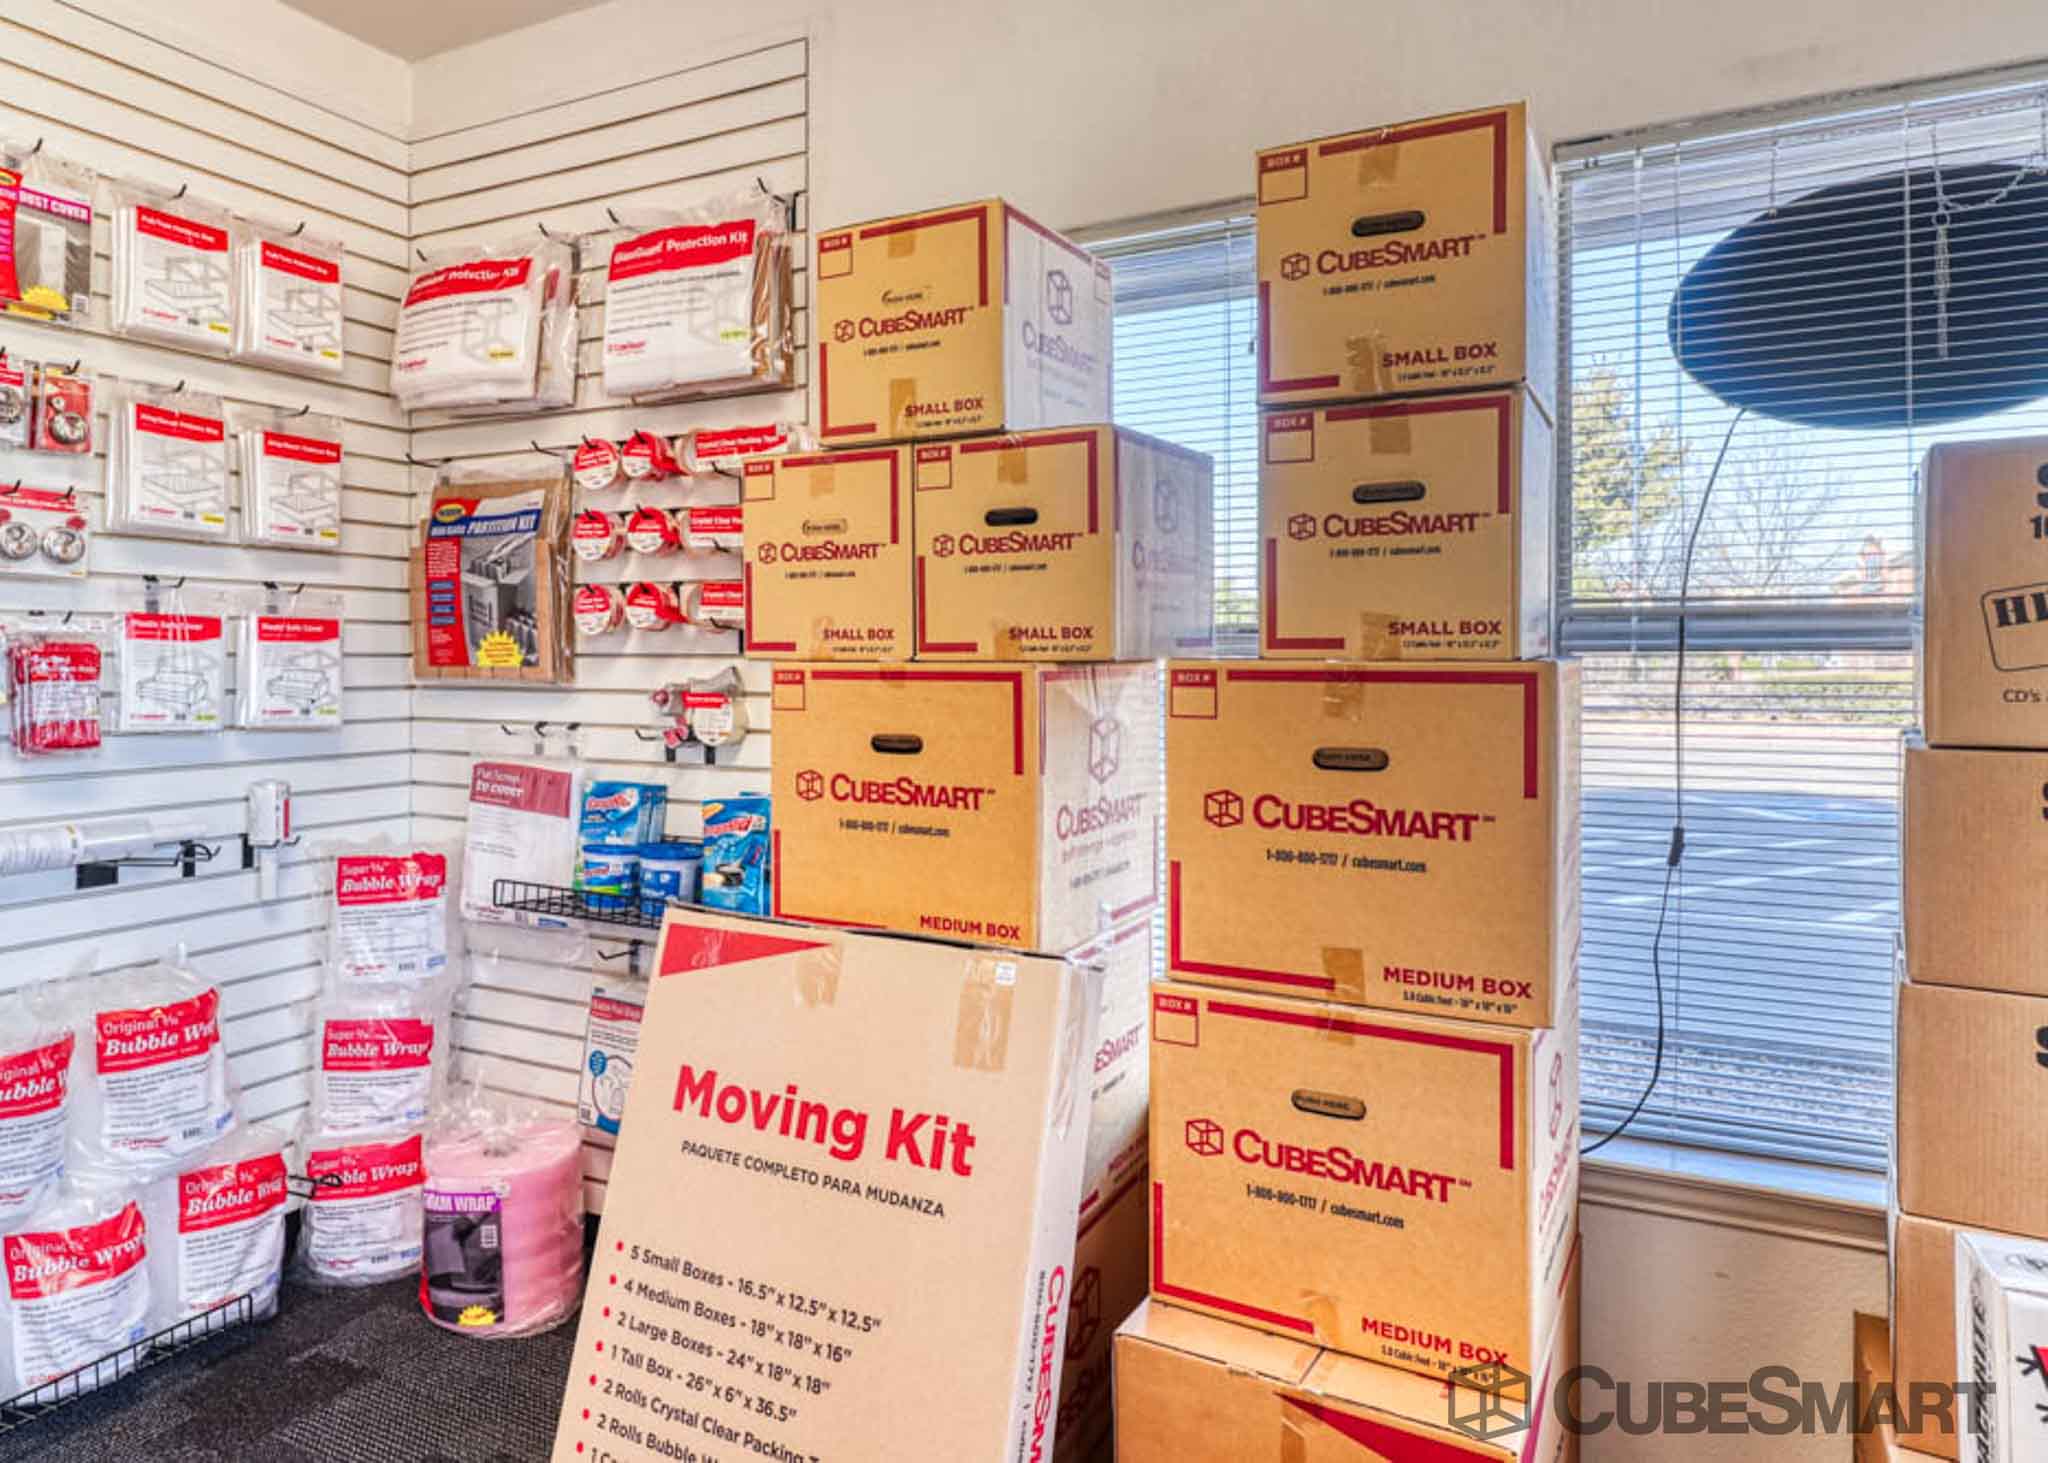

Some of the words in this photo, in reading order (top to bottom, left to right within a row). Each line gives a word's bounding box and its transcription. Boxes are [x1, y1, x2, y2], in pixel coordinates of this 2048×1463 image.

[665, 234, 727, 252] Protection
[728, 231, 749, 244] Kit
[1382, 348, 1449, 368] SMALL
[1454, 341, 1498, 361] BOX
[904, 401, 952, 418] SMALL
[953, 397, 984, 412] BOX
[517, 512, 537, 532] KIT
[823, 627, 865, 641] SMALL
[868, 627, 895, 641] BOX
[1008, 627, 1057, 641] SMALL
[1061, 625, 1094, 640] BOX
[1389, 620, 1454, 635] SMALL
[1459, 619, 1502, 635] BOX
[1177, 673, 1201, 683] BOX
[1352, 857, 1427, 873] cubesmart.com
[343, 876, 395, 893] Bubble
[919, 915, 982, 935] MEDIUM
[986, 923, 1021, 940] BOX
[1383, 966, 1475, 991] MEDIUM
[1481, 977, 1533, 999] BOX
[1159, 996, 1181, 1009] BOX
[103, 1016, 160, 1035] Original
[105, 1031, 179, 1056] Bubble
[327, 1043, 379, 1058] Bubble
[383, 1041, 431, 1057] Wrap
[1094, 1029, 1139, 1073] ESMART
[0, 1076, 57, 1101] ubble
[673, 1064, 868, 1161] Moving
[885, 1108, 976, 1177] Kit
[370, 1161, 418, 1181] Wrap
[681, 1139, 741, 1167] PAQUETE
[744, 1155, 819, 1186] COMPLETO
[822, 1174, 861, 1197] PARA
[865, 1185, 945, 1218] MUDANZA
[186, 1187, 256, 1216] Bubble
[425, 1192, 453, 1212] OAM
[455, 1193, 498, 1212] WRAP
[1330, 1202, 1405, 1229] cubesmart.com
[14, 1255, 91, 1283] Bubble
[94, 1236, 141, 1265] Wrap
[630, 1245, 640, 1260] 5
[642, 1249, 680, 1273] Small
[682, 1261, 724, 1287] Boxes
[738, 1278, 775, 1300] 16.5"
[776, 1292, 785, 1305] x
[789, 1292, 828, 1316] 12.5"
[828, 1308, 837, 1321] x
[841, 1308, 882, 1333] 12.5"
[624, 1279, 634, 1293] 4
[636, 1281, 690, 1313] Medium
[694, 1301, 736, 1328] Boxes
[751, 1319, 775, 1338] 18"
[775, 1331, 785, 1344] x
[788, 1331, 813, 1350] 18"
[813, 1342, 823, 1355] x
[826, 1343, 852, 1363] 16"
[617, 1311, 627, 1326] 2
[629, 1315, 668, 1342] Large
[671, 1329, 713, 1358] Boxes
[726, 1349, 755, 1368] 24"
[755, 1361, 764, 1374] x
[767, 1362, 792, 1381] 18"
[792, 1374, 802, 1387] x
[805, 1375, 830, 1395] 18"
[1361, 1317, 1452, 1354] MEDIUM
[1459, 1341, 1508, 1366] BOX
[611, 1345, 618, 1360] 1
[621, 1347, 643, 1367] Tall
[646, 1359, 673, 1381] Box
[685, 1371, 712, 1392] 26"
[712, 1384, 722, 1398] x
[725, 1385, 743, 1403] 6"
[743, 1396, 753, 1410] x
[755, 1396, 797, 1423] 36.5"
[603, 1379, 613, 1395] 2
[615, 1382, 648, 1409] Rolls
[650, 1396, 699, 1429] Crystal
[702, 1416, 741, 1443] Clear
[743, 1431, 803, 1463] Packing
[597, 1413, 607, 1430] 2
[609, 1416, 642, 1444] Rolls
[645, 1432, 697, 1463] Bubble
